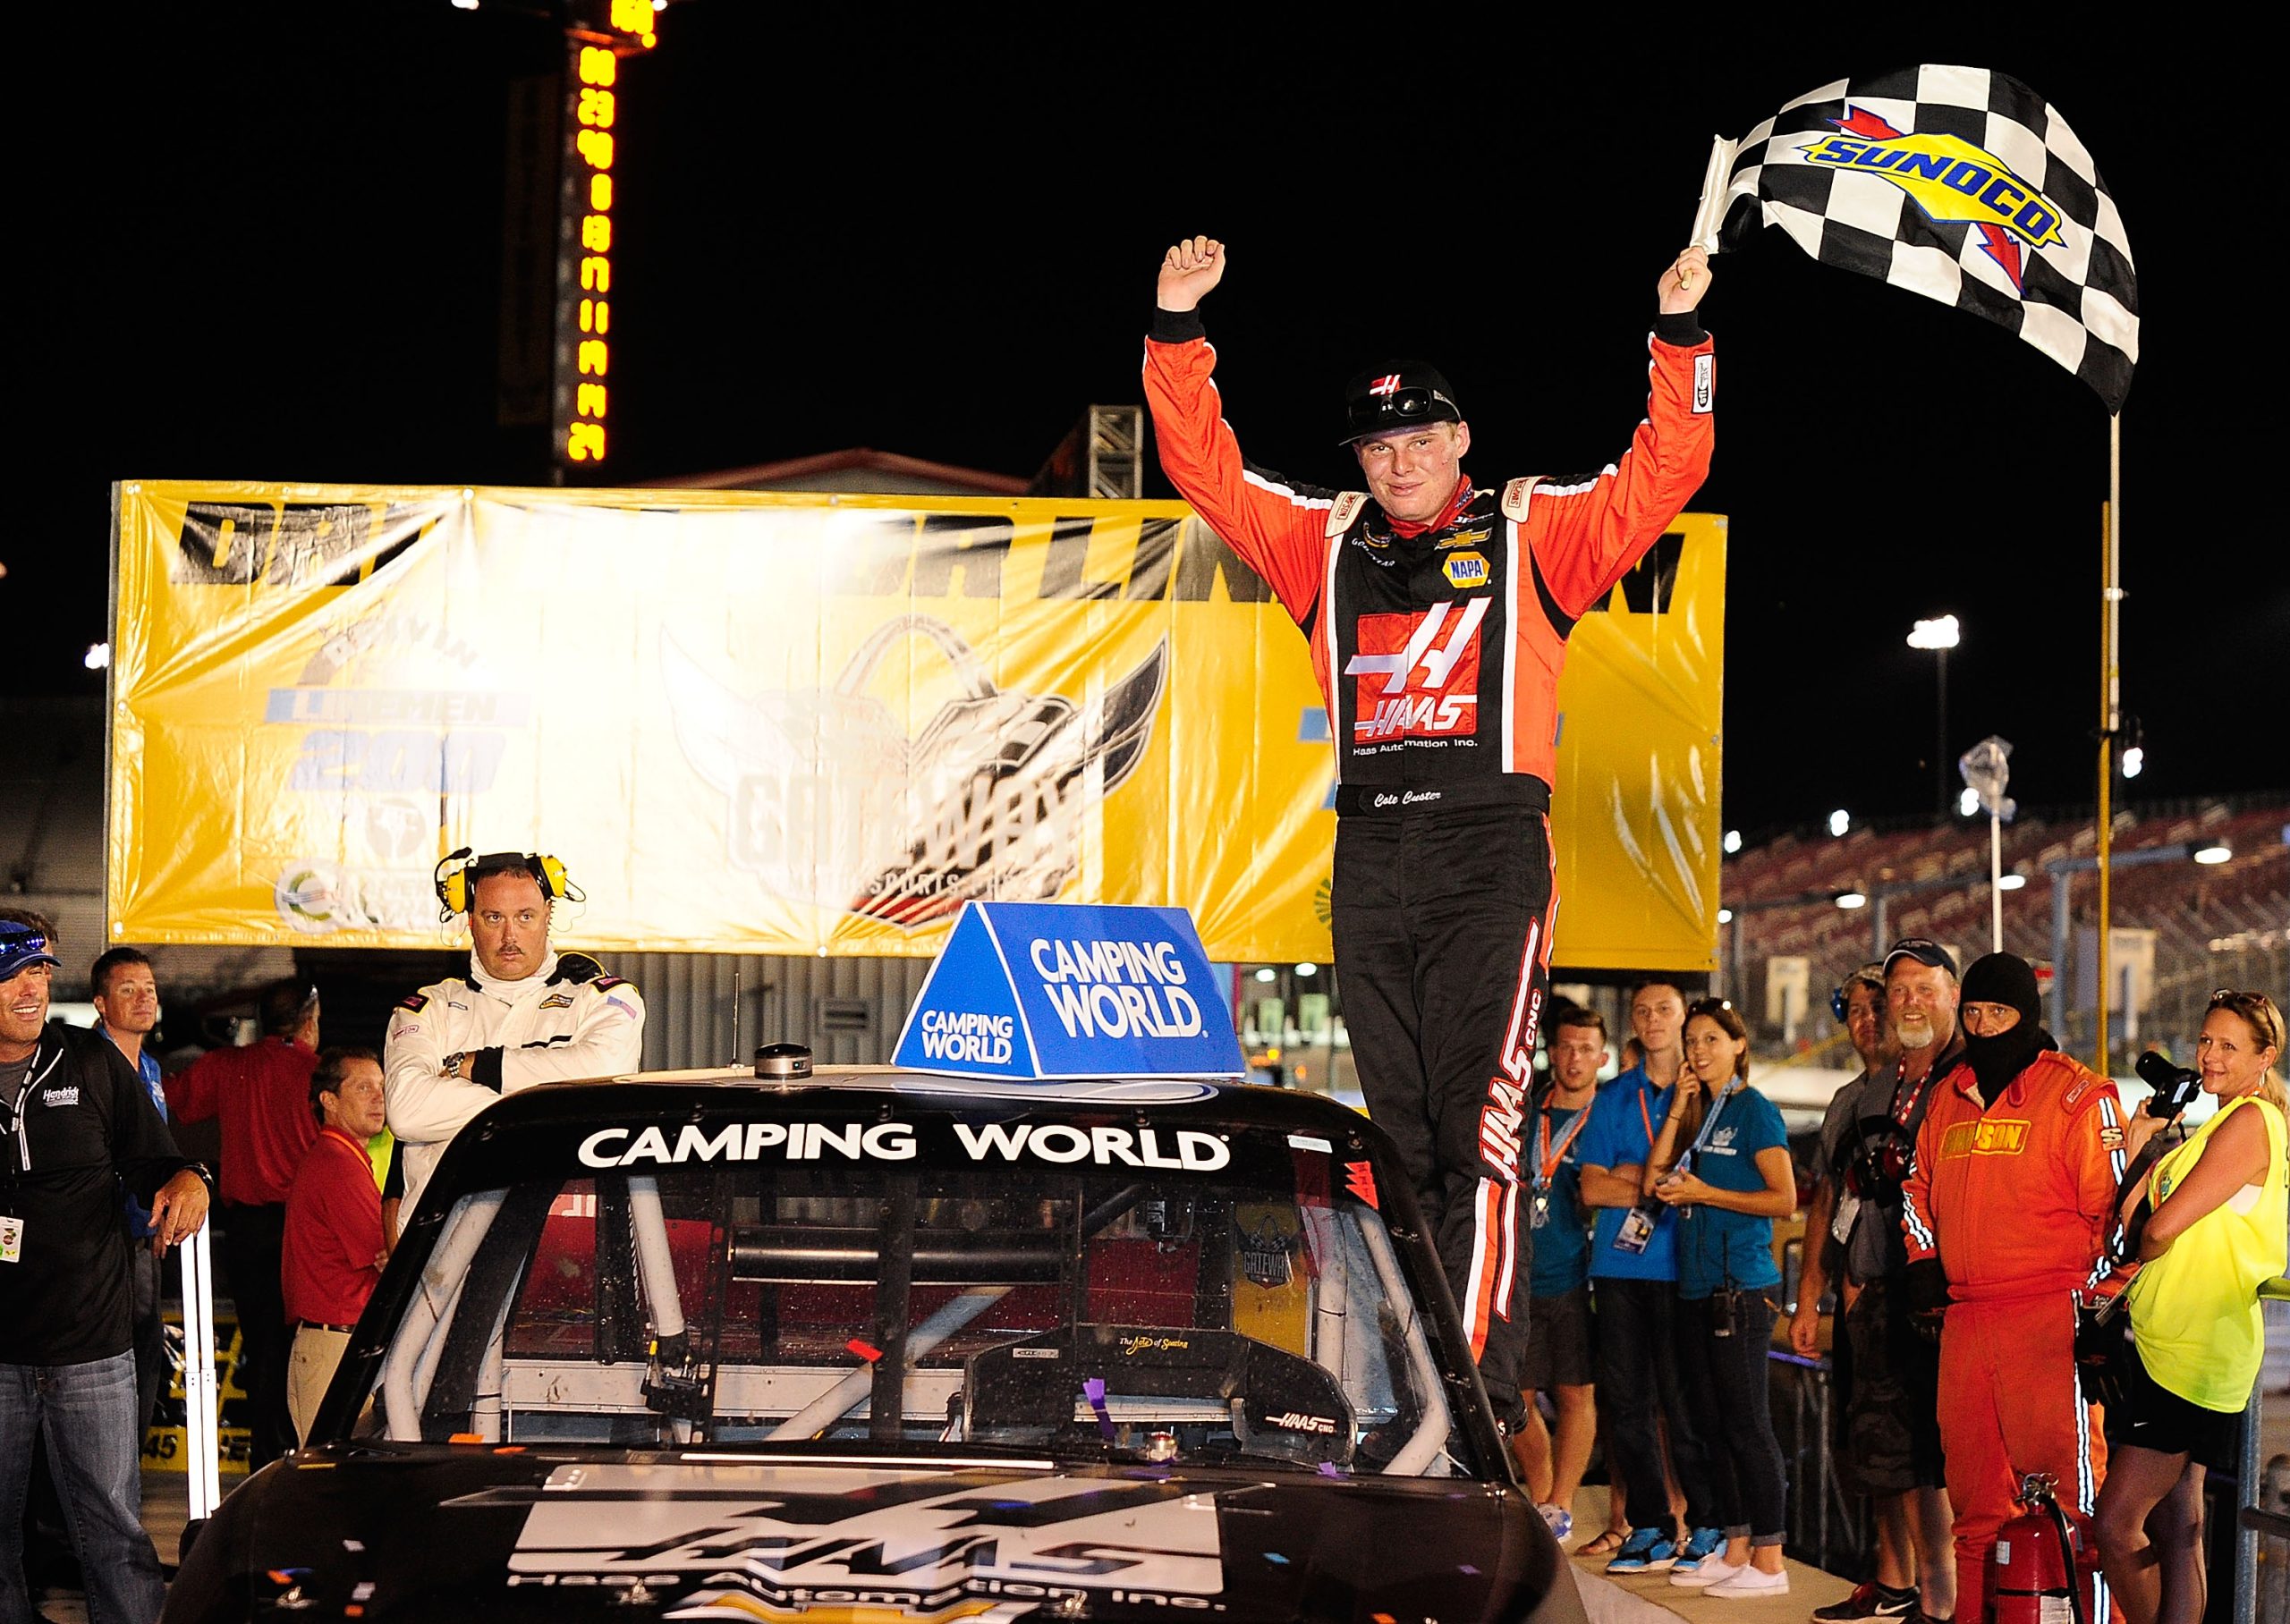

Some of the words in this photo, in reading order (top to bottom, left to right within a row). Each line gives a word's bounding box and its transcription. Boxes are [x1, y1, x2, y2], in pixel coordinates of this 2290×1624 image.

[1819, 140, 2058, 241] SUNOCO
[1510, 479, 1524, 505] SIMPS
[1449, 559, 1484, 579] NAPA
[1354, 694, 1478, 737] HAAS
[288, 730, 506, 792] 200
[1353, 747, 1377, 756] Haas
[1379, 740, 1448, 752] Automation
[1374, 792, 1398, 808] Cole
[1402, 791, 1442, 805] Custer
[1030, 938, 1187, 985] CAMPING
[921, 1010, 1014, 1039] CAMPING
[1042, 985, 1203, 1038] WORLD
[1525, 992, 1542, 1046] CNC
[922, 1031, 1013, 1064] WORLD
[578, 1123, 917, 1168] CAMPING
[953, 1123, 1230, 1171] WORLD
[1154, 1338, 1162, 1348] of
[1265, 1413, 1336, 1431] HAAS
